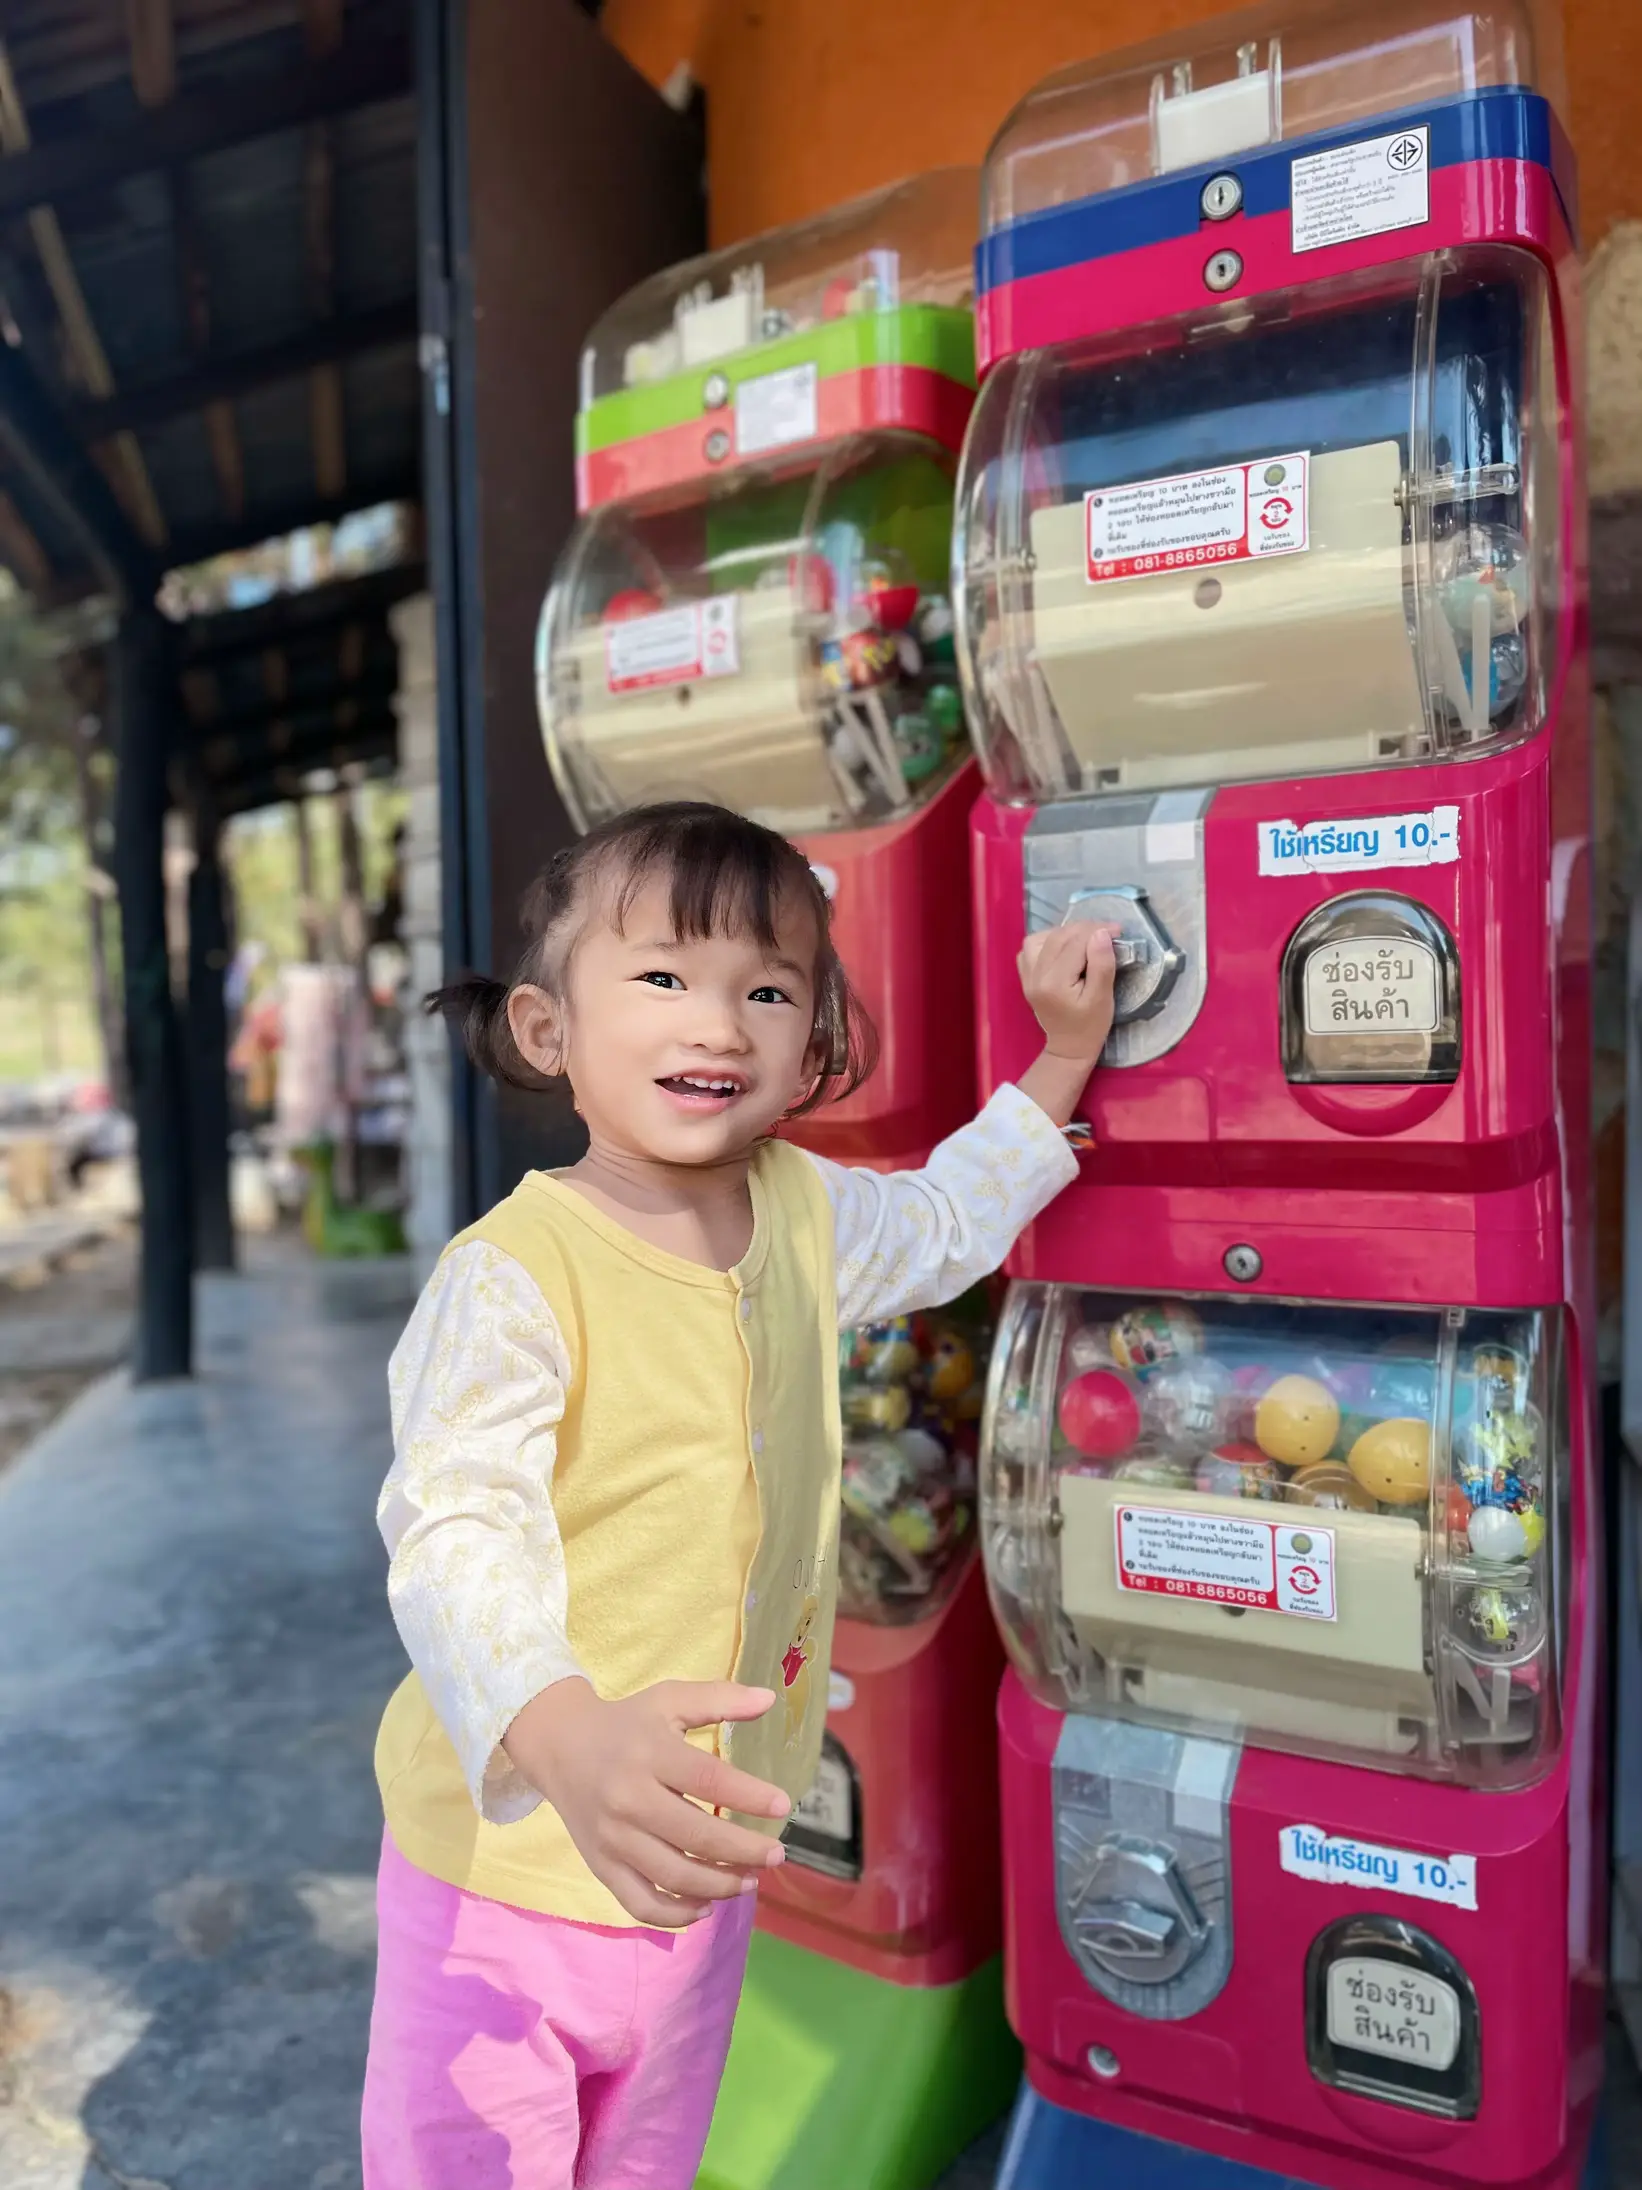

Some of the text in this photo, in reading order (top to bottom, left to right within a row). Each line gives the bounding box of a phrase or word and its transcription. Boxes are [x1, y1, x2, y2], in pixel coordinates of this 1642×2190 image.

[1172, 484, 1188, 494] บาท
[1095, 563, 1115, 577] Tel
[1134, 543, 1238, 572] 081-8865056
[1269, 822, 1450, 859] ใช้เหรียญ 10.-
[1322, 949, 1414, 984] ช่องรับ
[1331, 987, 1410, 1021] สินค้า
[1200, 1522, 1216, 1531] บาท
[1128, 1575, 1148, 1588] Tel
[1165, 1581, 1267, 1605] 081-8865056
[1291, 1829, 1468, 1891] ใช้เหรียญ 10.-
[1346, 1969, 1436, 2016] ช่องรับ
[1354, 2004, 1431, 2052] สินค้า
